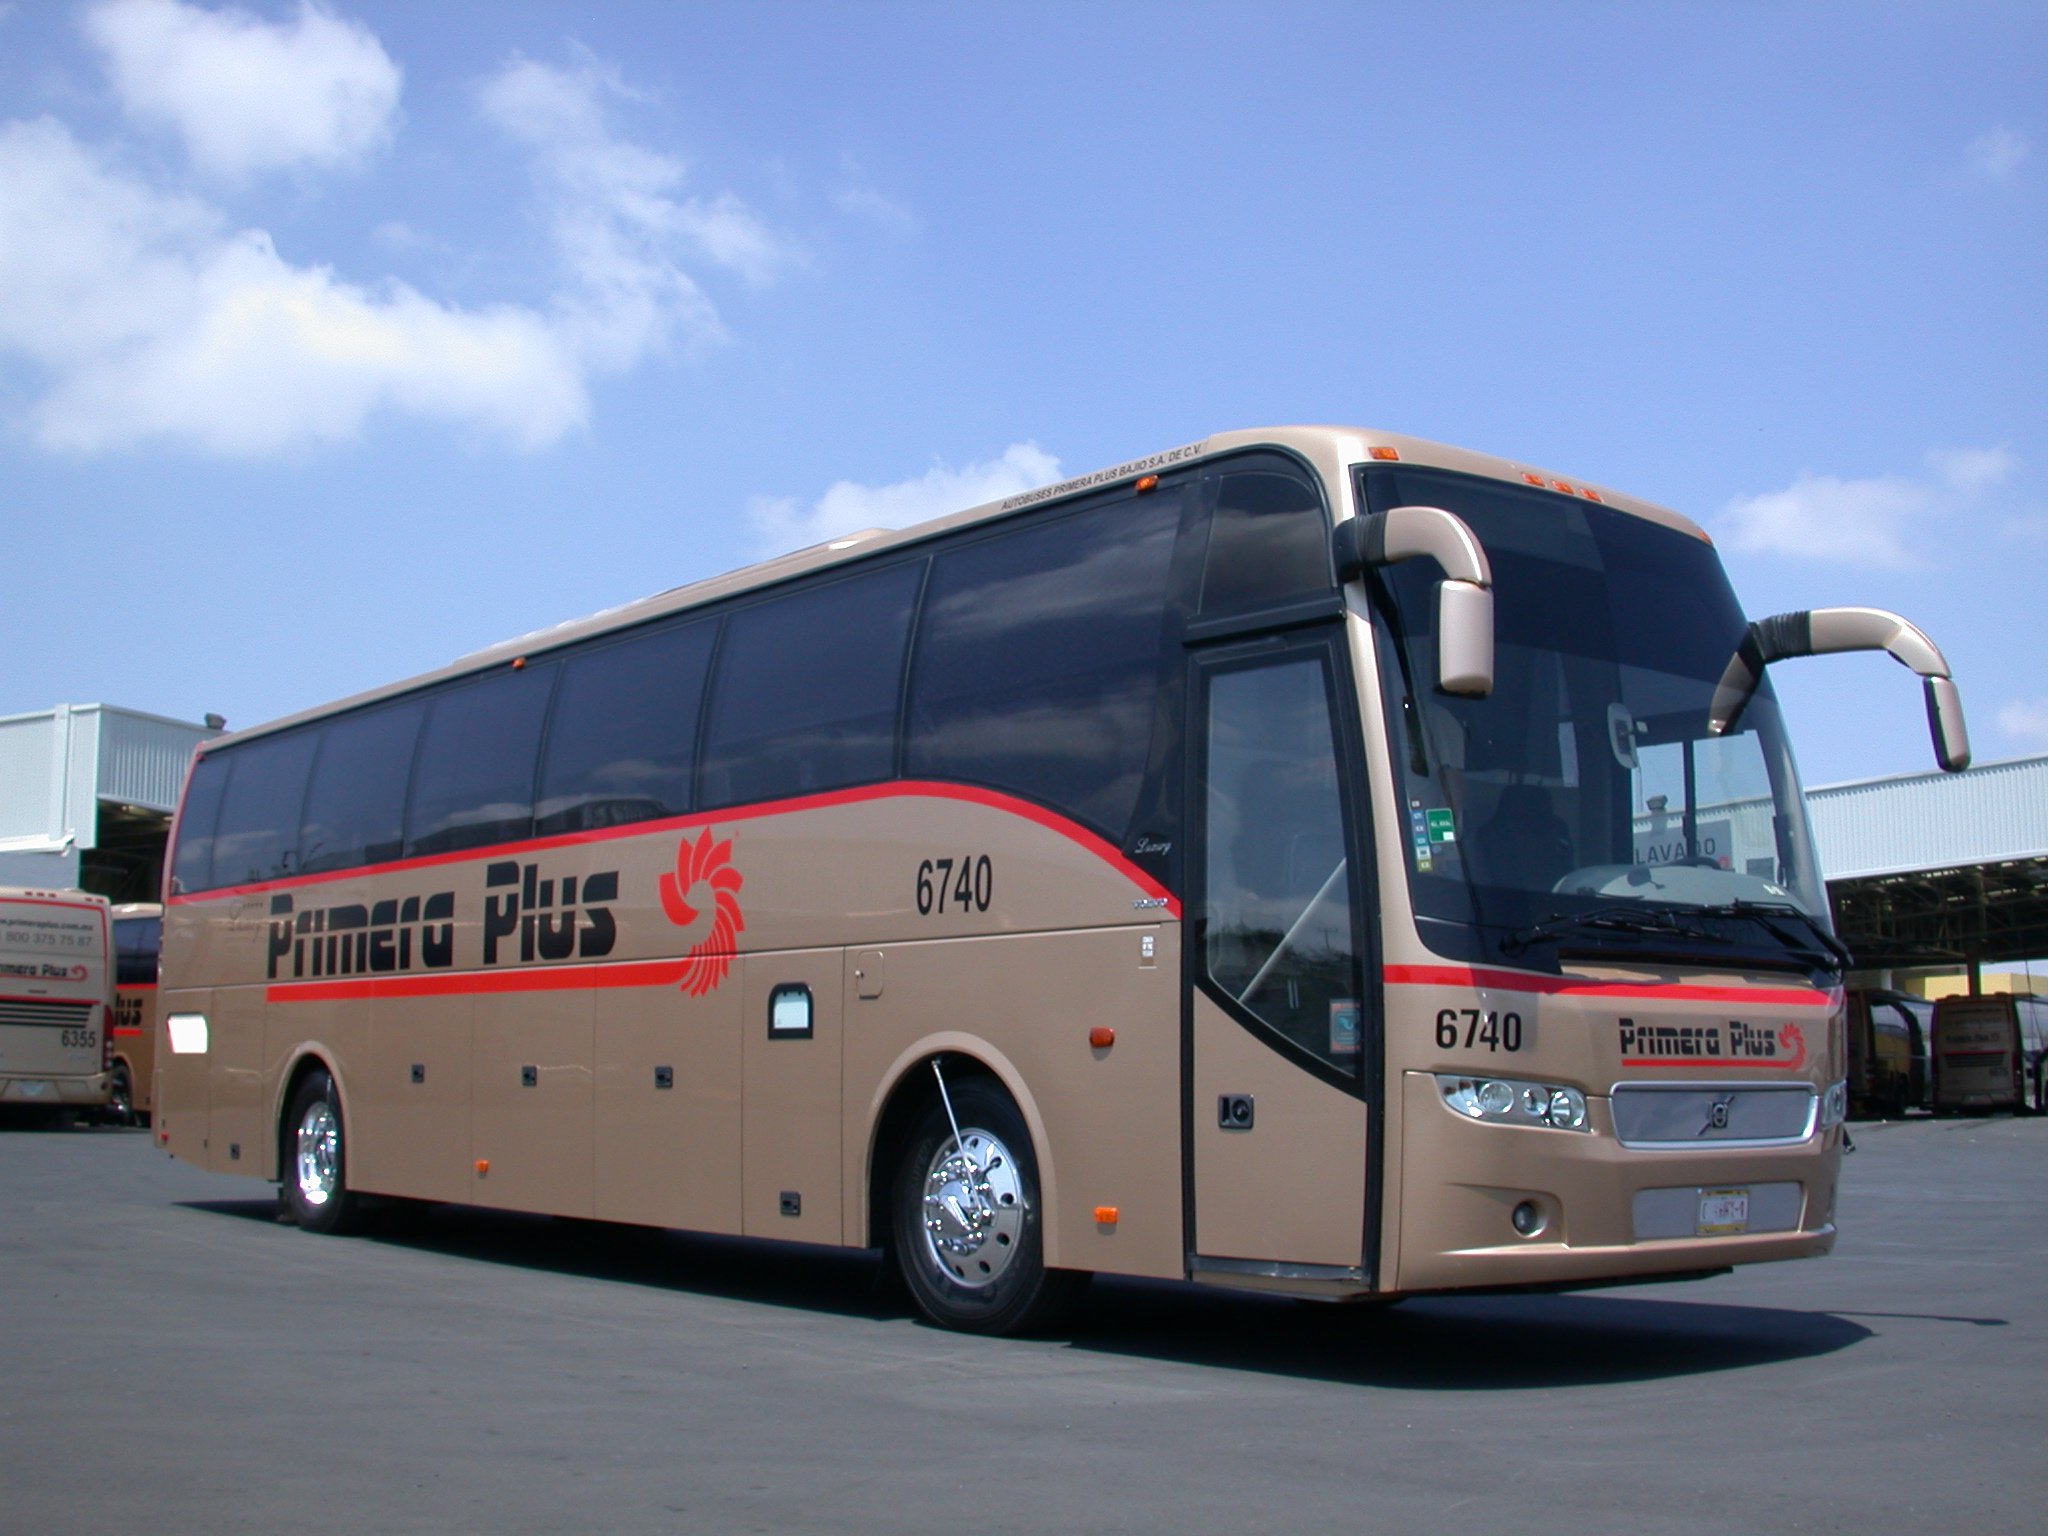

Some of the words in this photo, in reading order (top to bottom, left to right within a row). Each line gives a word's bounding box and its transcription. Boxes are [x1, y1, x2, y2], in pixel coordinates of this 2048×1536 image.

[1001, 487, 1052, 510] AUTOBUSES
[1053, 474, 1093, 496] PRIMERA
[1094, 468, 1118, 484] PLUS
[1168, 449, 1182, 462] DE
[1134, 837, 1172, 855] Luxury
[917, 854, 992, 916] 6740
[266, 892, 456, 979] Primera
[483, 860, 619, 965] Plus
[115, 992, 143, 1025] lus
[62, 1030, 96, 1048] 6355
[1435, 1009, 1522, 1052] 6740
[1619, 1018, 1720, 1055] Primera
[1729, 1020, 1776, 1056] Plus
